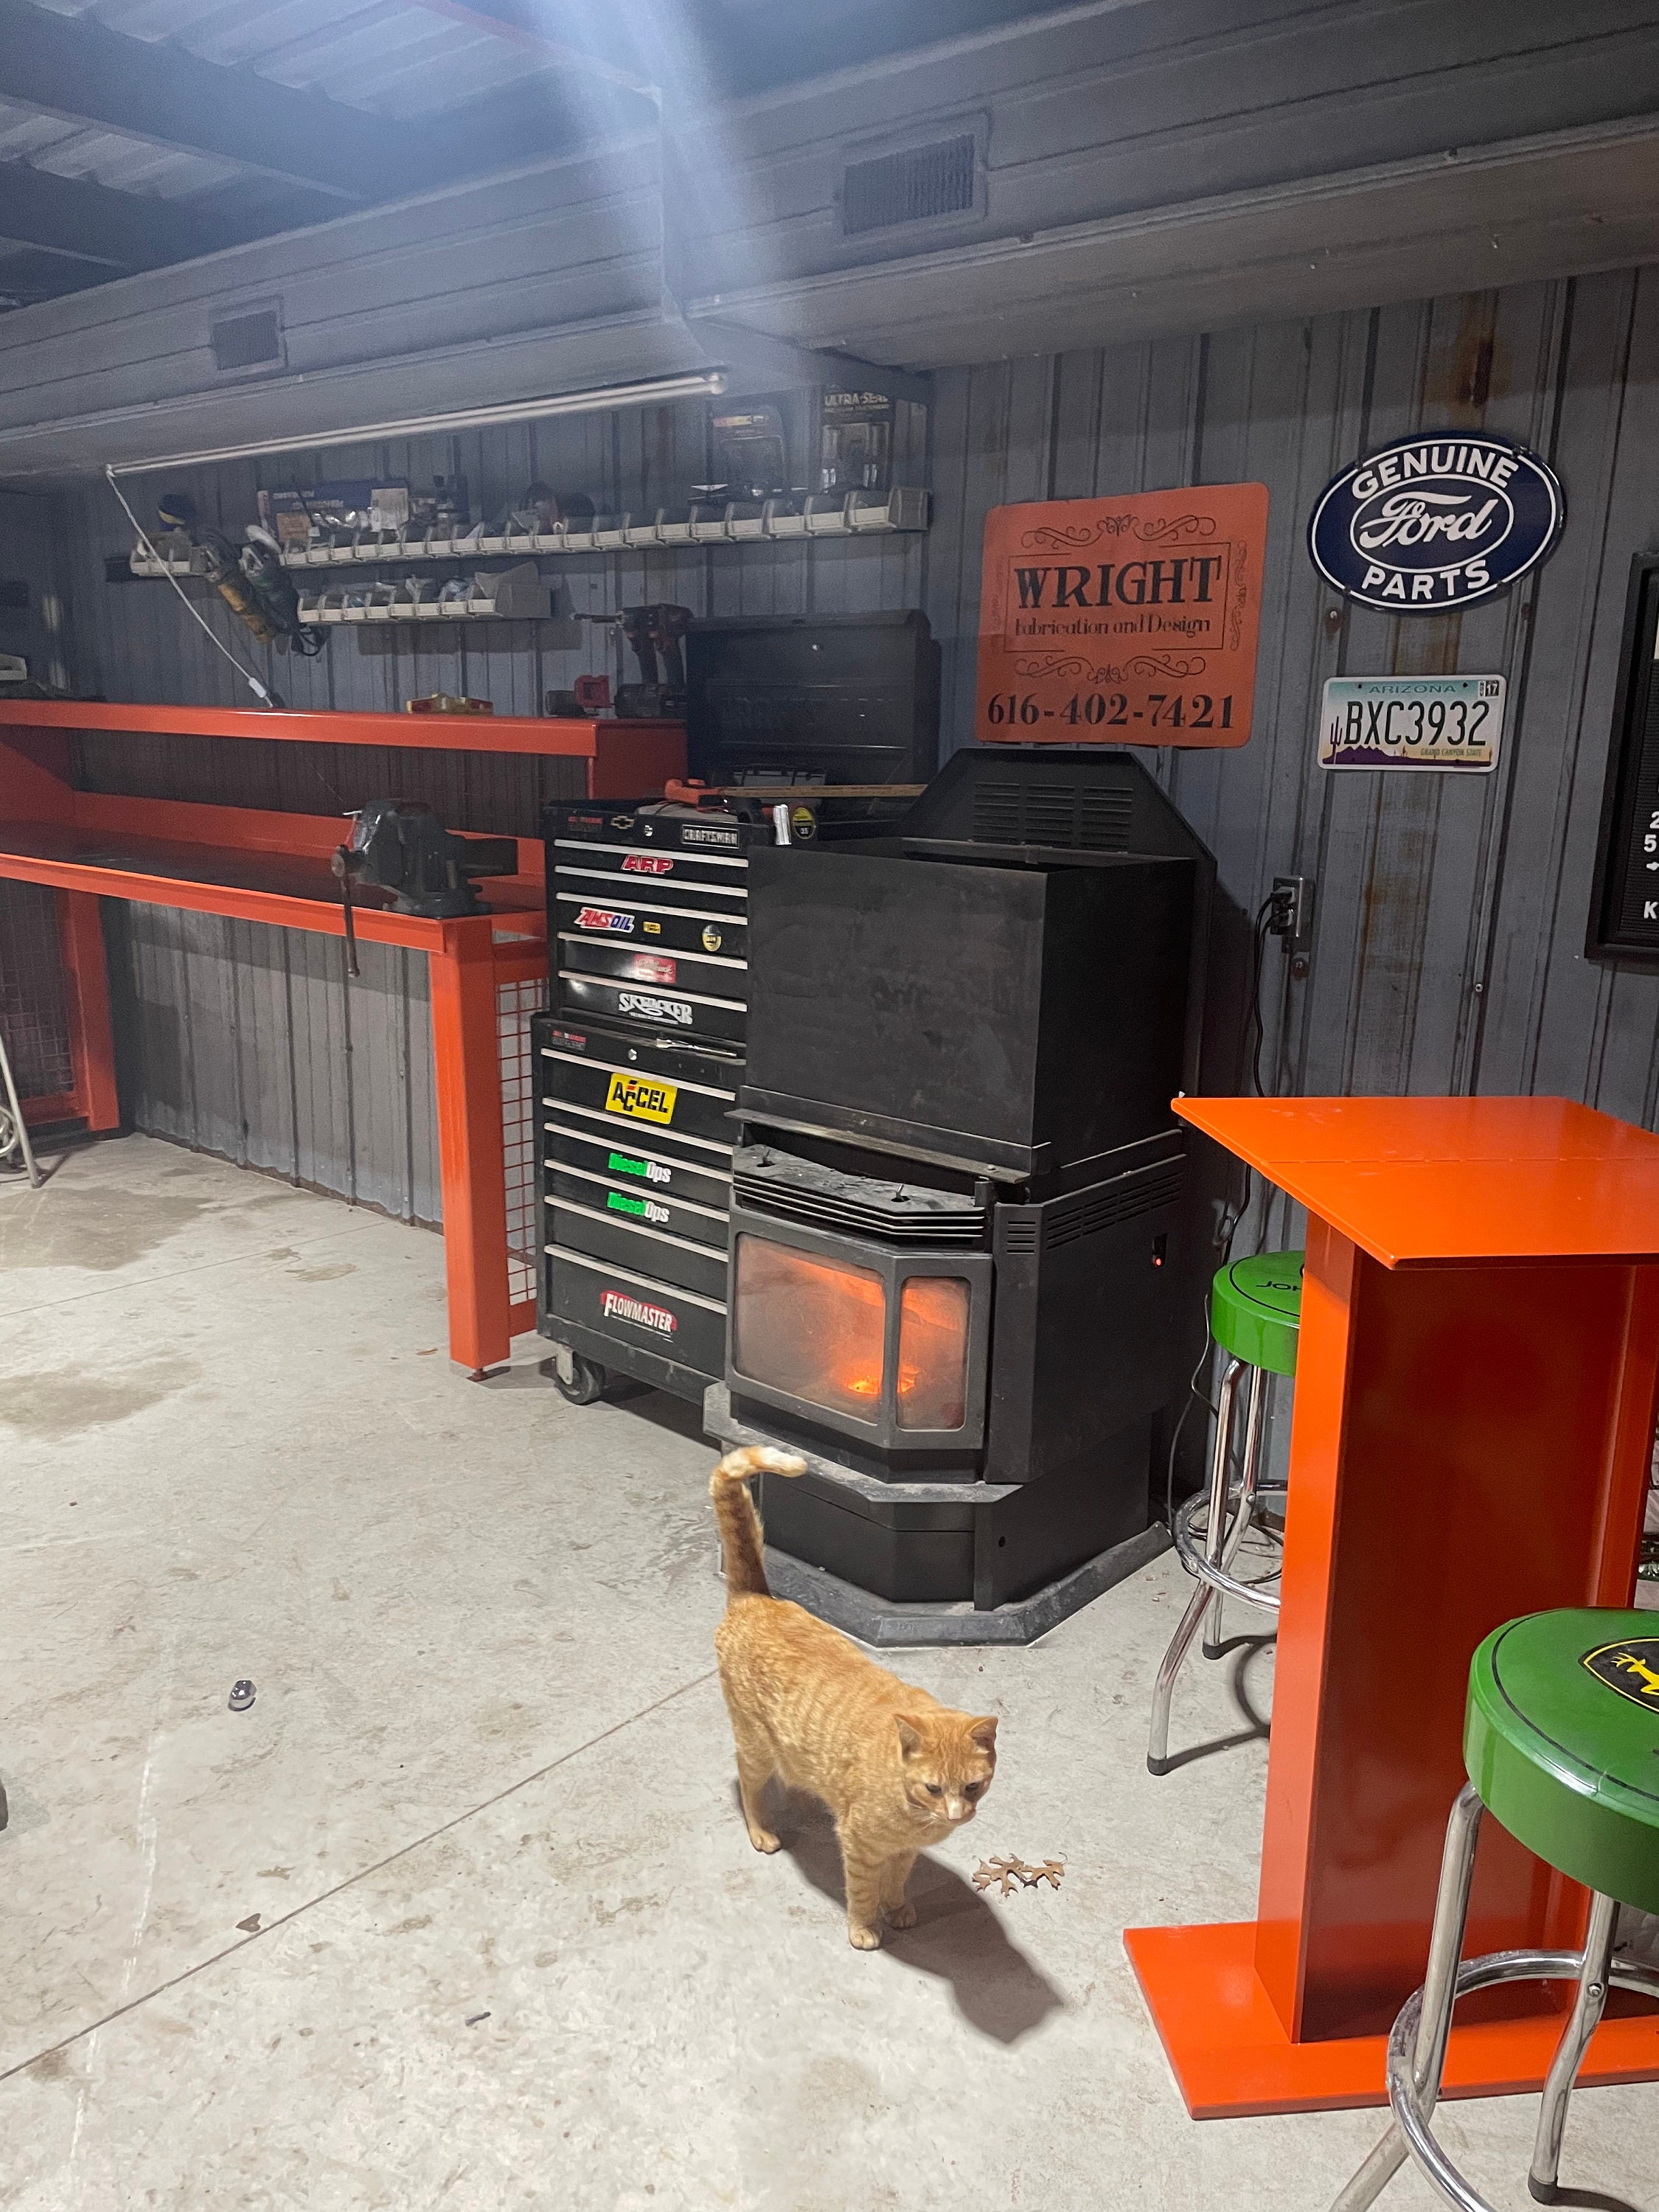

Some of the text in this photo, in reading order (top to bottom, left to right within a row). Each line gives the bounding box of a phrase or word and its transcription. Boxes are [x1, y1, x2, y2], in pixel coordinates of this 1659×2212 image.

[1352, 446, 1520, 500] GENUINE
[1359, 490, 1499, 549] Ford
[1014, 555, 1222, 609] WRIGHT
[1361, 559, 1490, 601] PARTS
[1113, 613, 1143, 634] and
[1147, 613, 1211, 639] Design
[1368, 684, 1457, 694] ARIZONA
[1486, 684, 1498, 695] 17
[987, 692, 1234, 729] 616-402-7421
[1343, 700, 1490, 746] BXC3932
[1420, 748, 1482, 757] GRAND CANYON STATE
[1644, 834, 1658, 852] 5
[621, 855, 674, 874] ARP
[577, 908, 633, 932] AMSOIL
[1644, 901, 1659, 919] K
[611, 1080, 669, 1113] ACCEL
[604, 1293, 672, 1332] FLOWMASTER
